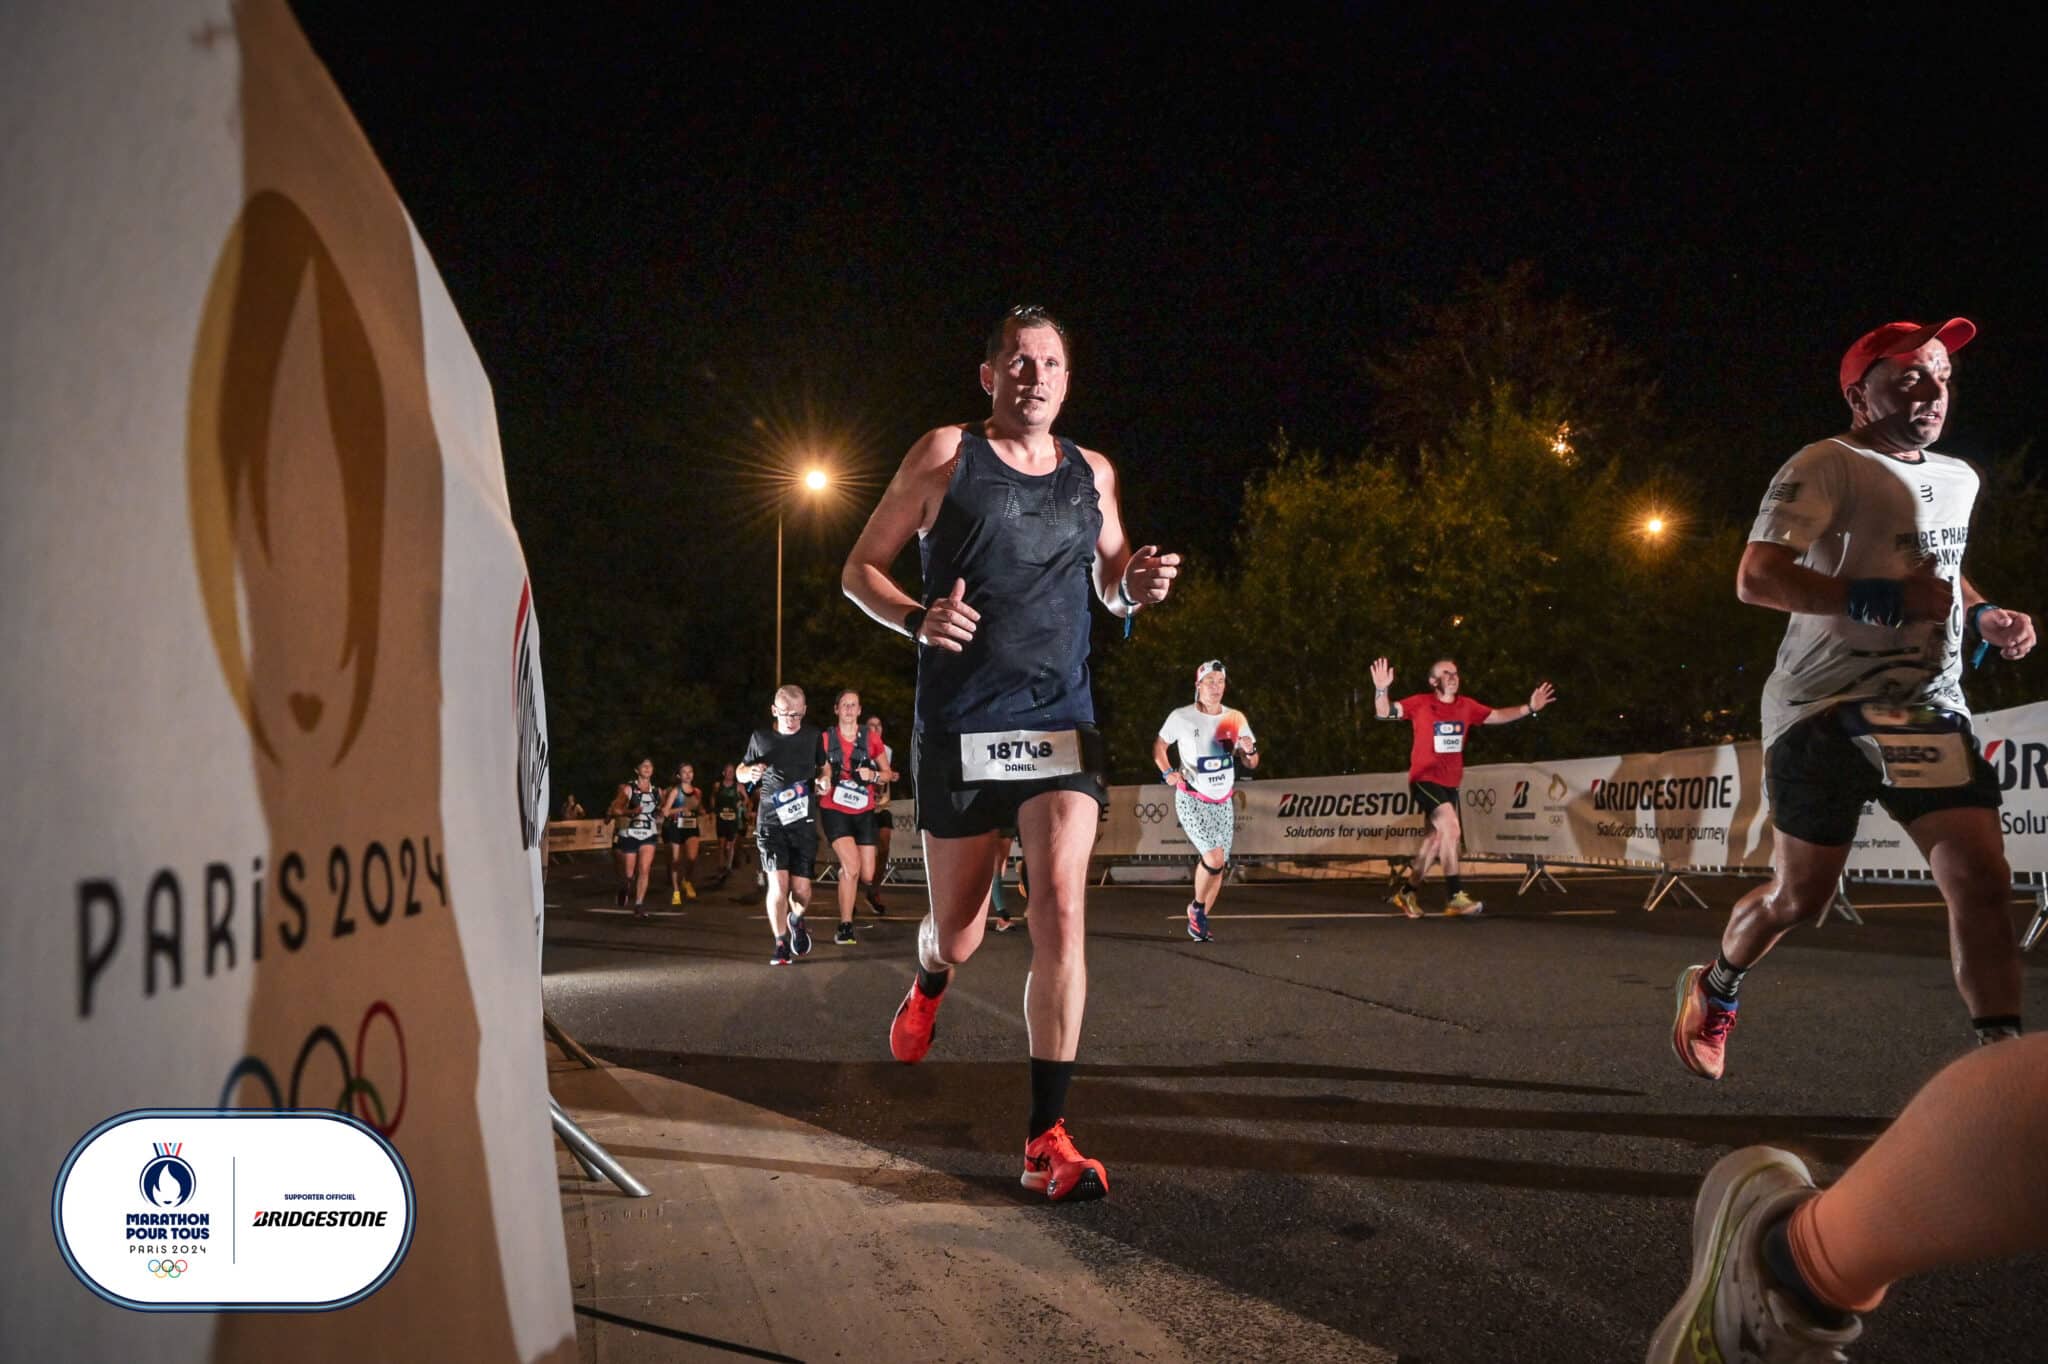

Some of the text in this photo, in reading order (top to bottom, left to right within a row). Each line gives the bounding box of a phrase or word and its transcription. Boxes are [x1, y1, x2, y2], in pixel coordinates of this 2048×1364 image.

[987, 741, 1053, 760] 18748
[1005, 763, 1037, 772] DANIEL
[1590, 774, 1733, 811] BRIDGESTONE
[1278, 793, 1424, 818] BRIDGESTON
[1284, 824, 1425, 840] Solutions for your journe
[1596, 822, 1729, 845] Solutions for your journey
[2001, 809, 2048, 834] Solu
[328, 836, 447, 939] 2024
